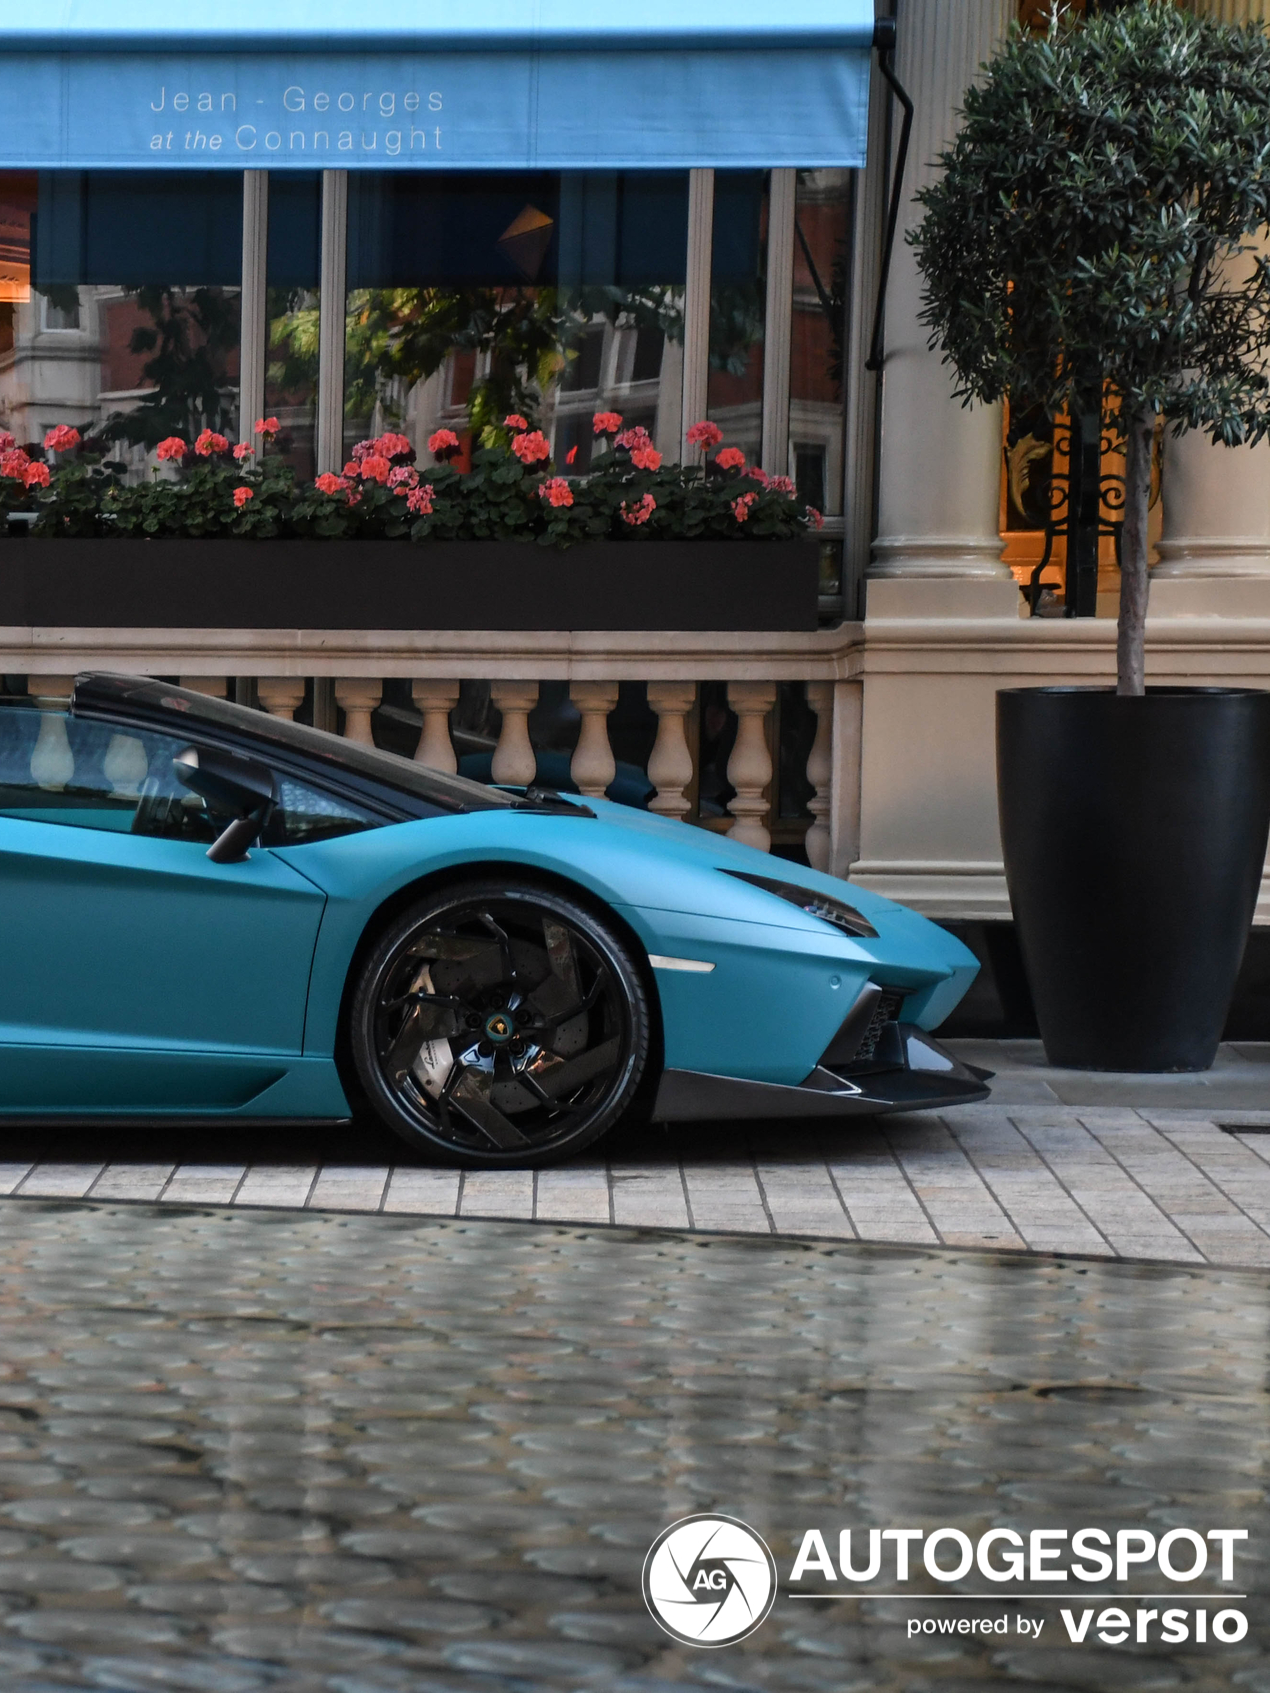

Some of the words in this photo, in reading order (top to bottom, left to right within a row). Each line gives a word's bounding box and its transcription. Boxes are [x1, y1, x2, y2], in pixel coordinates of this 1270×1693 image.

[150, 86, 237, 112] Jean
[283, 85, 443, 118] Georges
[149, 129, 174, 150] at
[184, 129, 223, 151] the
[235, 124, 443, 156] Connaught
